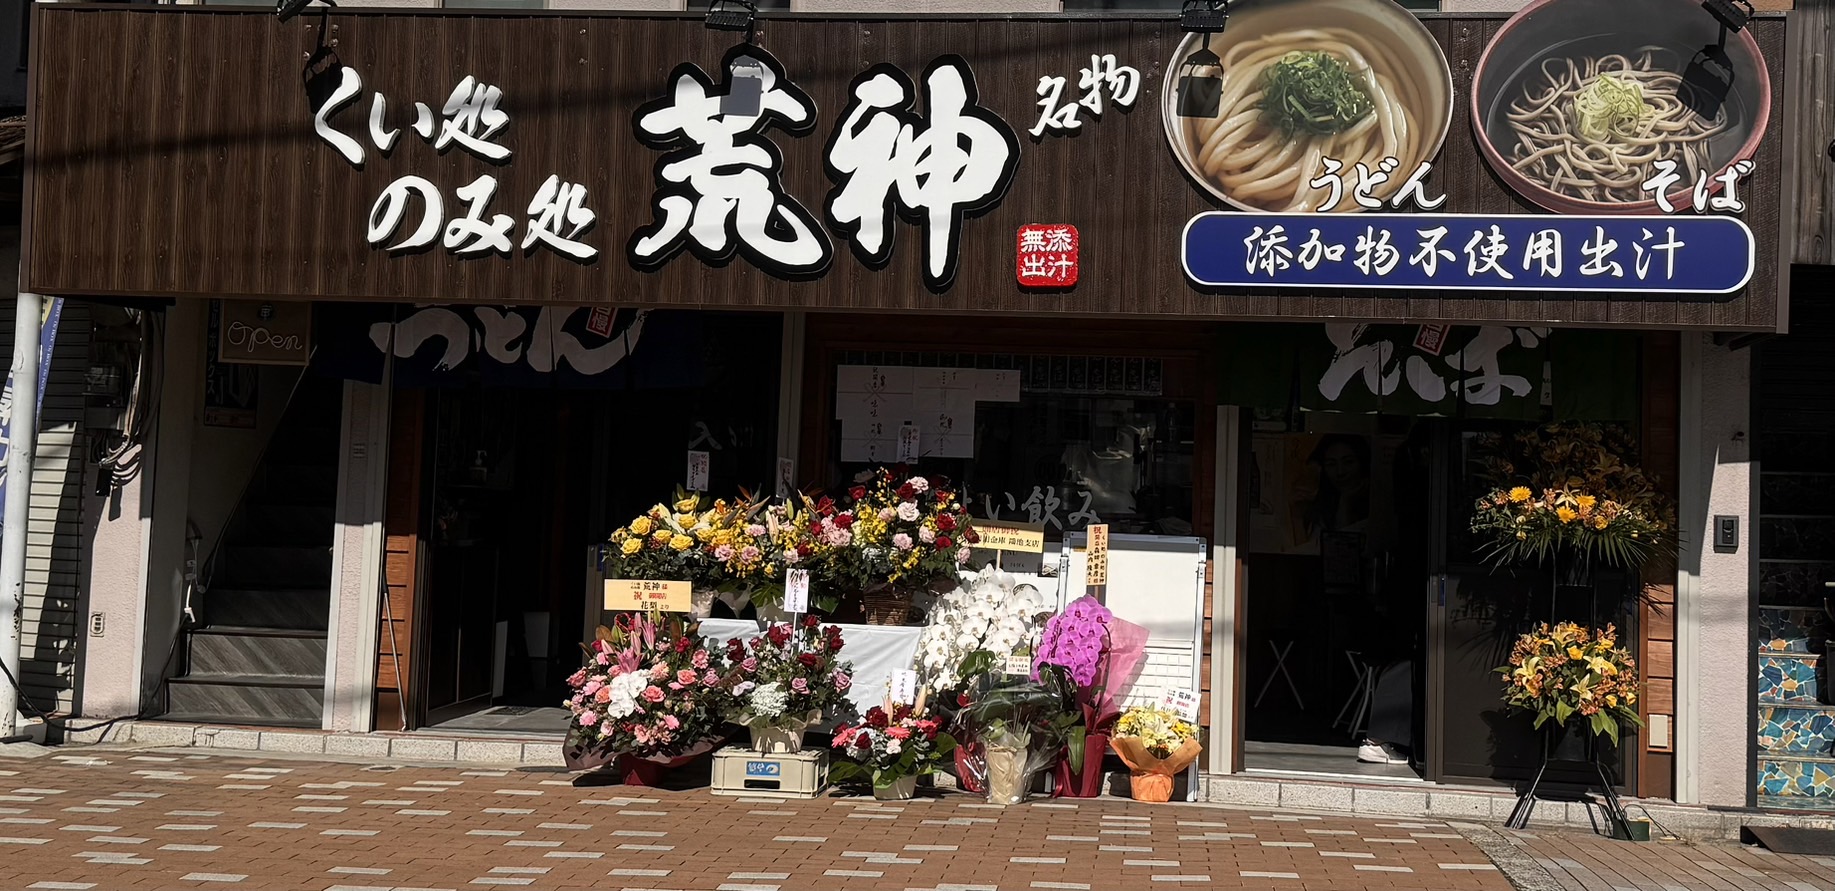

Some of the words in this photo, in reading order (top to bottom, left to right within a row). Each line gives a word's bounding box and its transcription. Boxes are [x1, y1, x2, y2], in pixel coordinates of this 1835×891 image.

[314, 66, 513, 165] くい処
[1028, 53, 1140, 137] 名物
[633, 62, 1010, 279] 荒神
[1309, 156, 1448, 212] うどん
[1641, 159, 1755, 213] そば
[366, 174, 599, 259] のみ処
[1243, 225, 1686, 281] 添加物不使用出汁
[227, 321, 303, 353] Open
